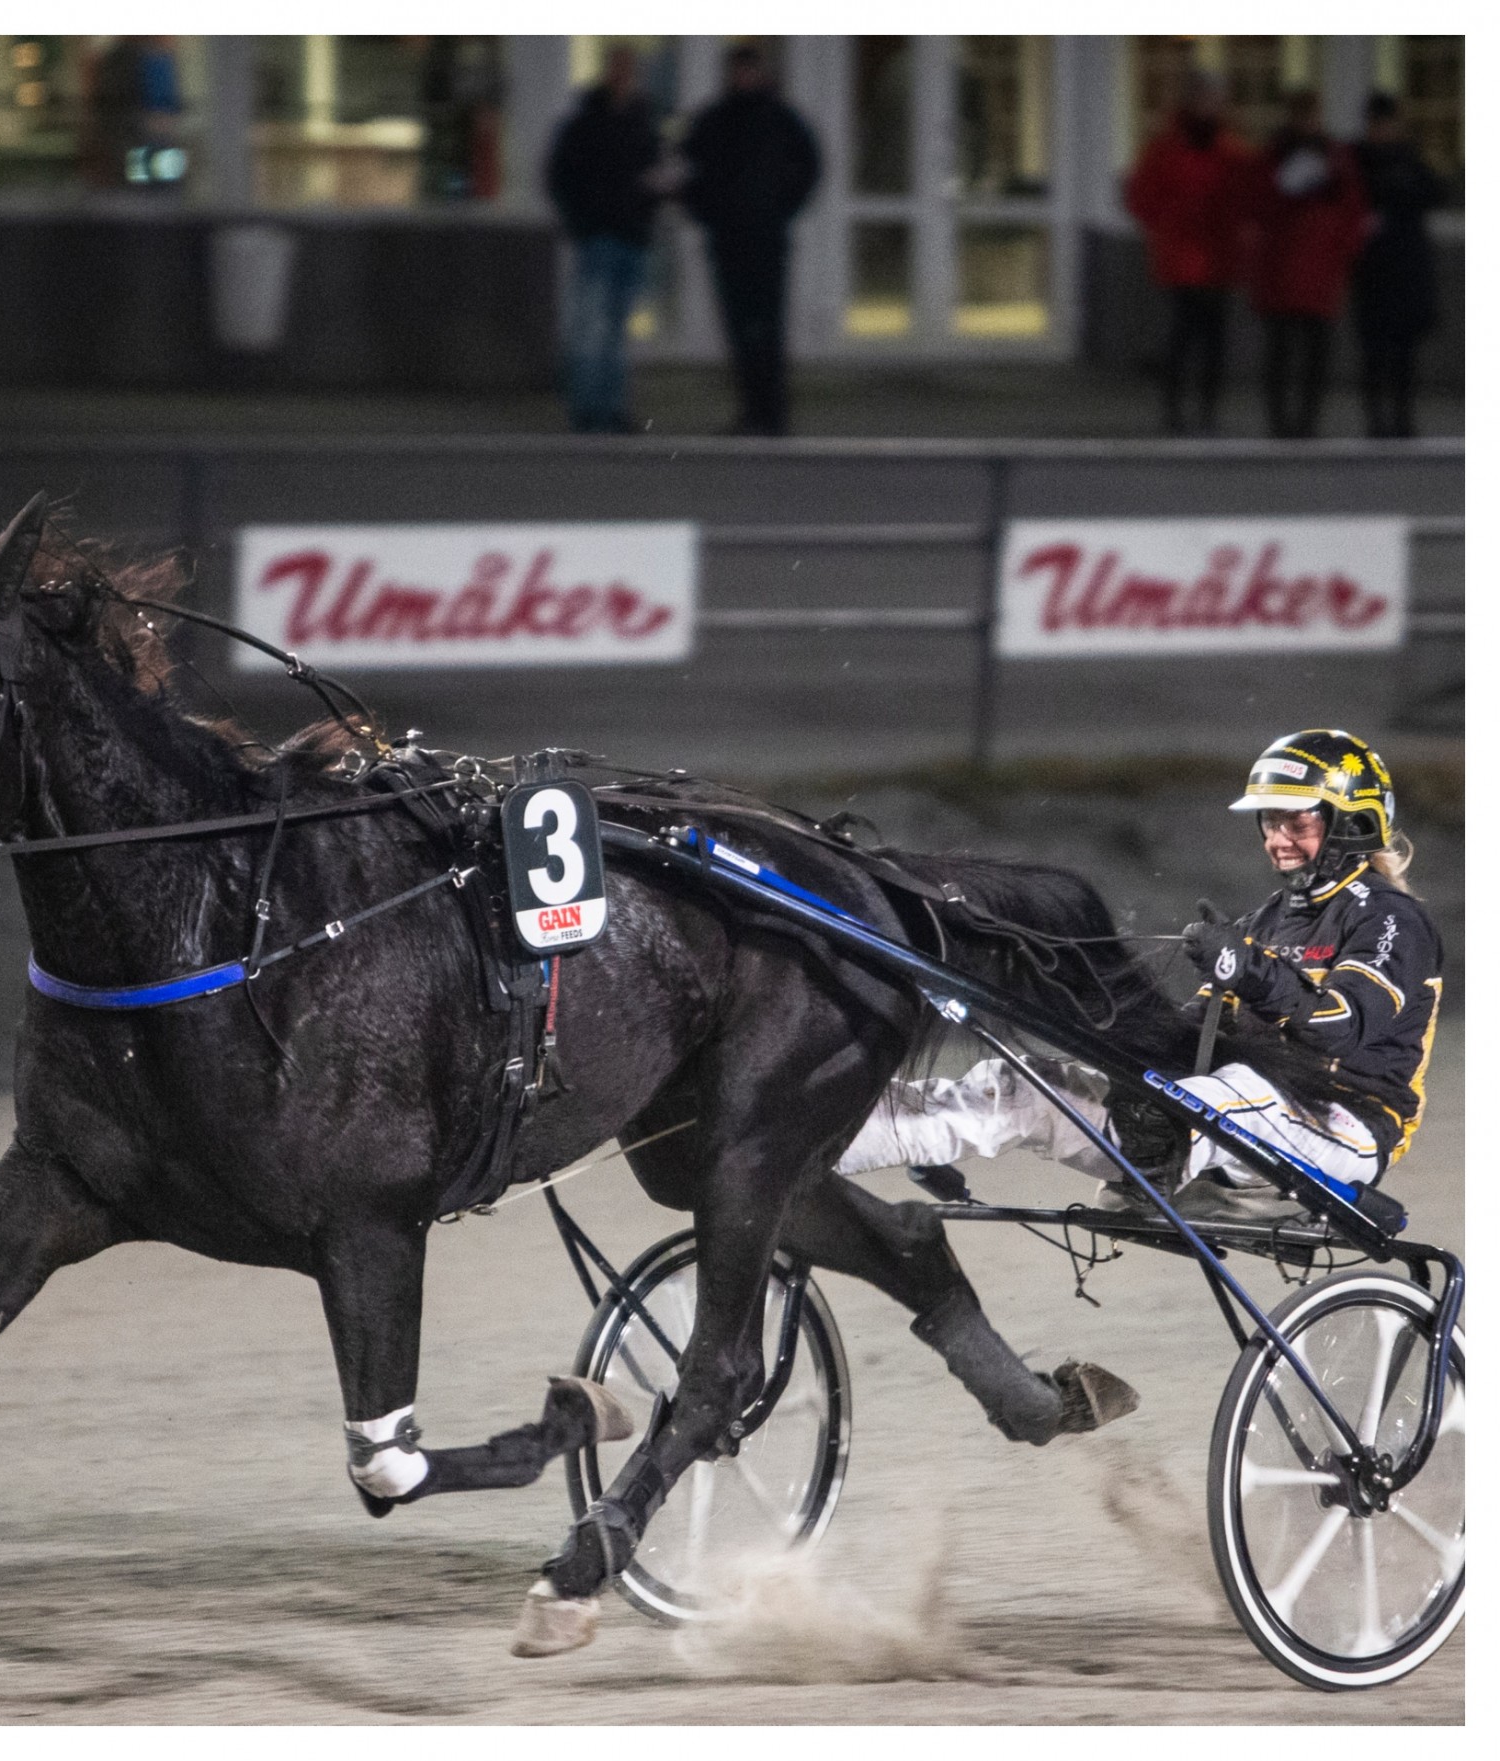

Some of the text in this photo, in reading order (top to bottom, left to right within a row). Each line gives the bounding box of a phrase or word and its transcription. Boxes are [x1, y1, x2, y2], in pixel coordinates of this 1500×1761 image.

[258, 550, 672, 645] Umåker
[1020, 542, 1388, 632] Umåker
[523, 788, 586, 906] 3
[538, 906, 582, 932] GAIN
[560, 928, 584, 940] FEEDS
